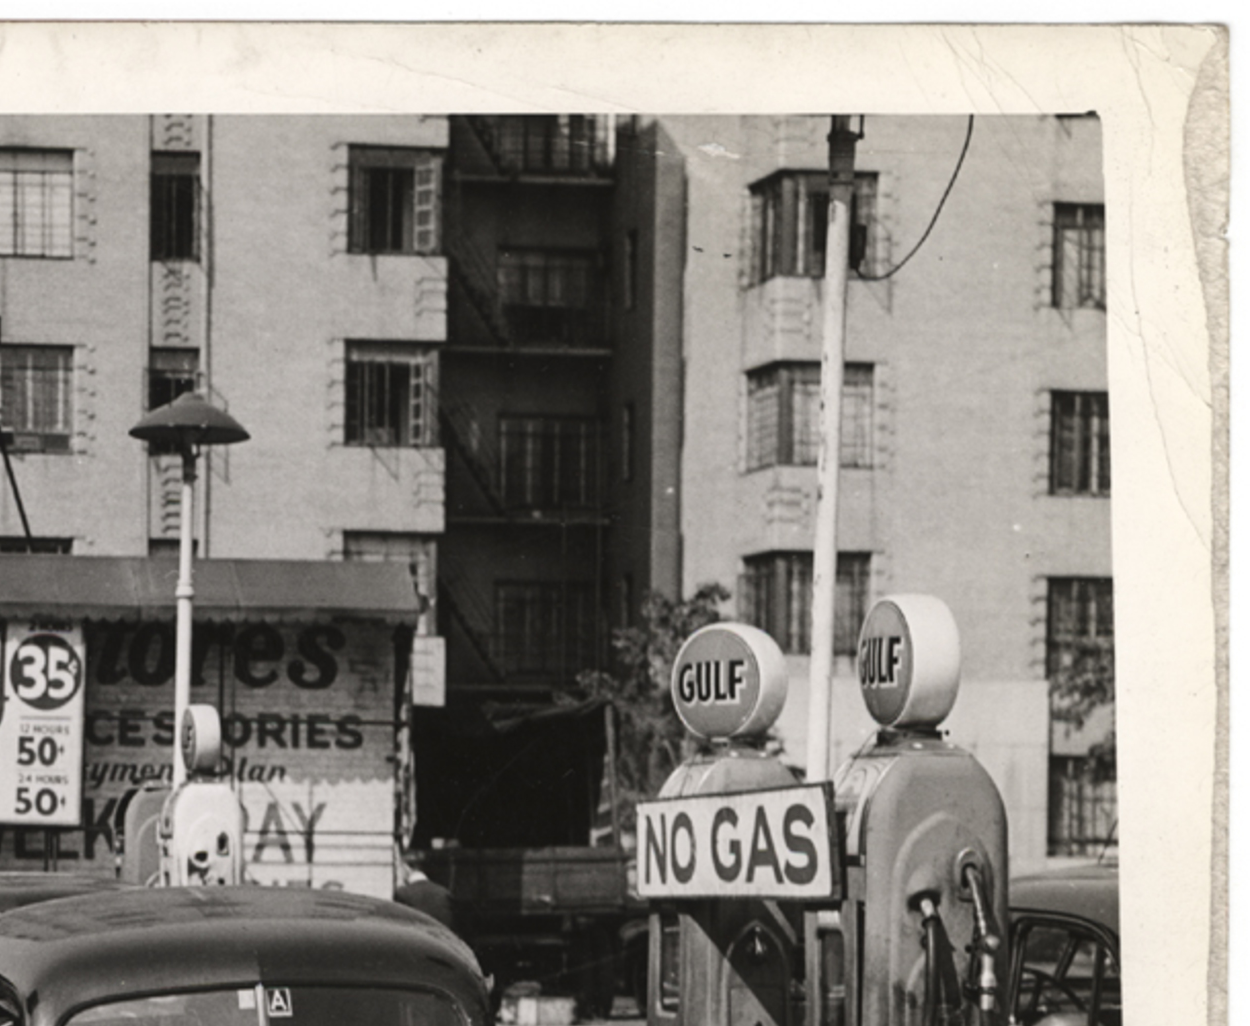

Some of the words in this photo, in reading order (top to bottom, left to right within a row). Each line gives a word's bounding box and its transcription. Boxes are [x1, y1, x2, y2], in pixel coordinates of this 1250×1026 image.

[92, 619, 347, 690] tores
[860, 635, 903, 686] GULF
[679, 659, 745, 703] GULF
[20, 723, 30, 734] 12
[33, 724, 70, 735] HOURS
[86, 712, 364, 750] CESORIES
[19, 773, 32, 784] 24
[36, 774, 69, 785] HOURS
[86, 762, 174, 788] ymen
[252, 802, 327, 864] AY
[645, 811, 697, 886] NO
[711, 804, 819, 886] GAS
[270, 988, 288, 1011] A
